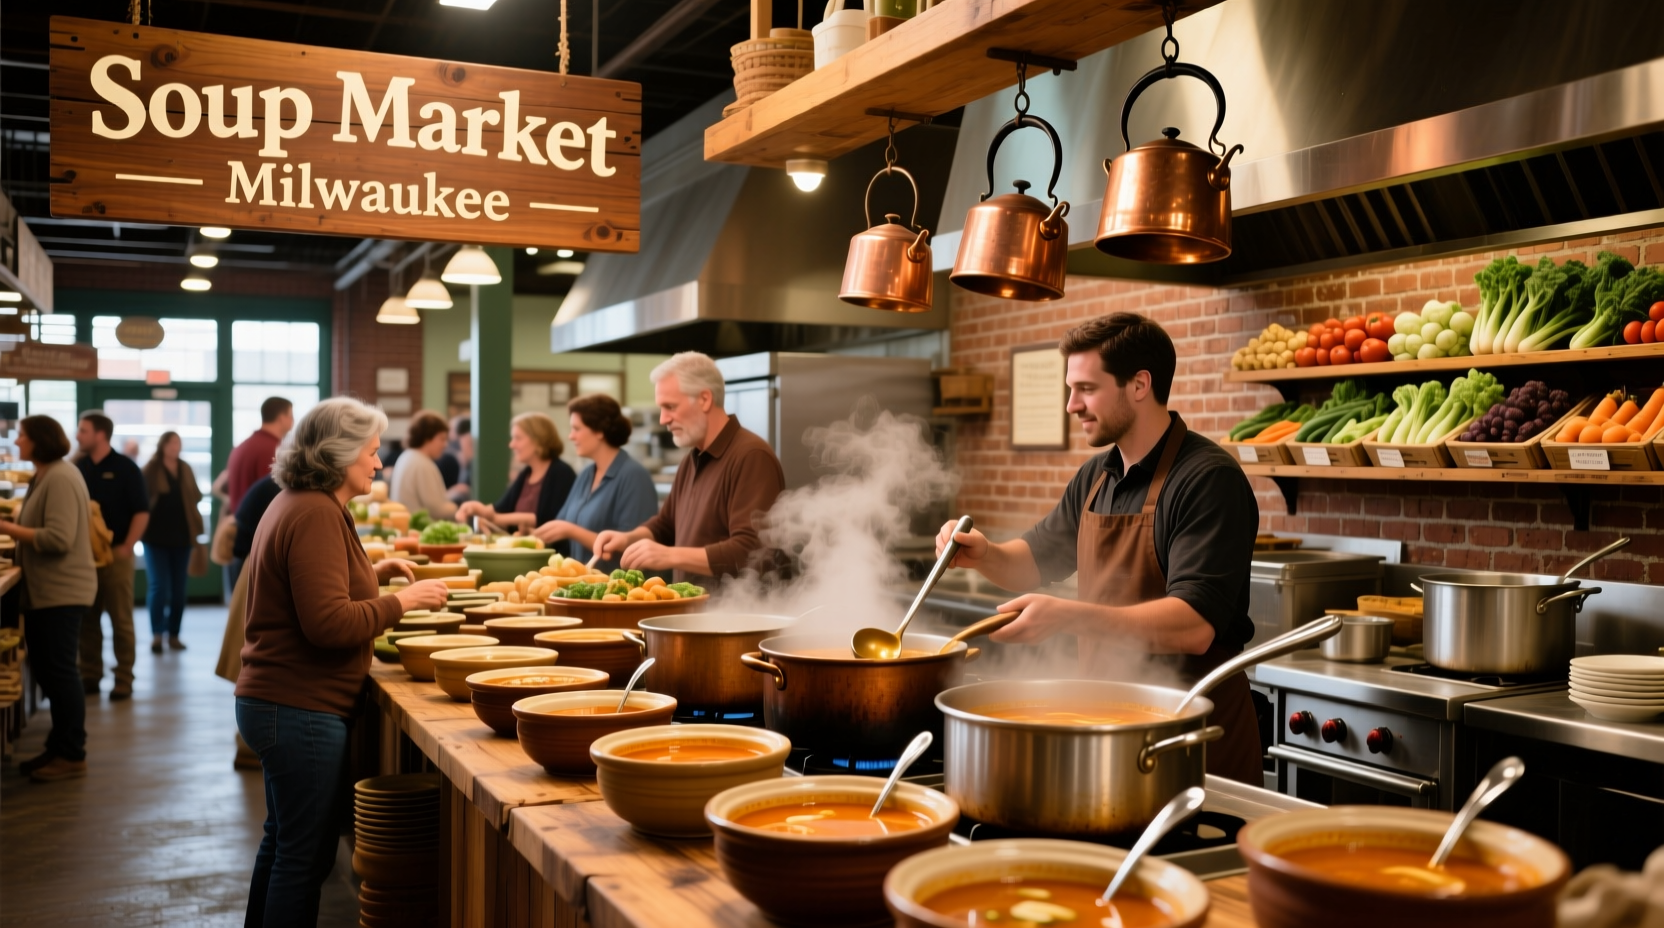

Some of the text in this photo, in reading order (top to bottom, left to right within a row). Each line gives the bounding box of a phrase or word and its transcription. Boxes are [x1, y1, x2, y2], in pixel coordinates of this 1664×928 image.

[90, 55, 617, 177] Soup Market
[225, 160, 510, 222] Milwaukee
